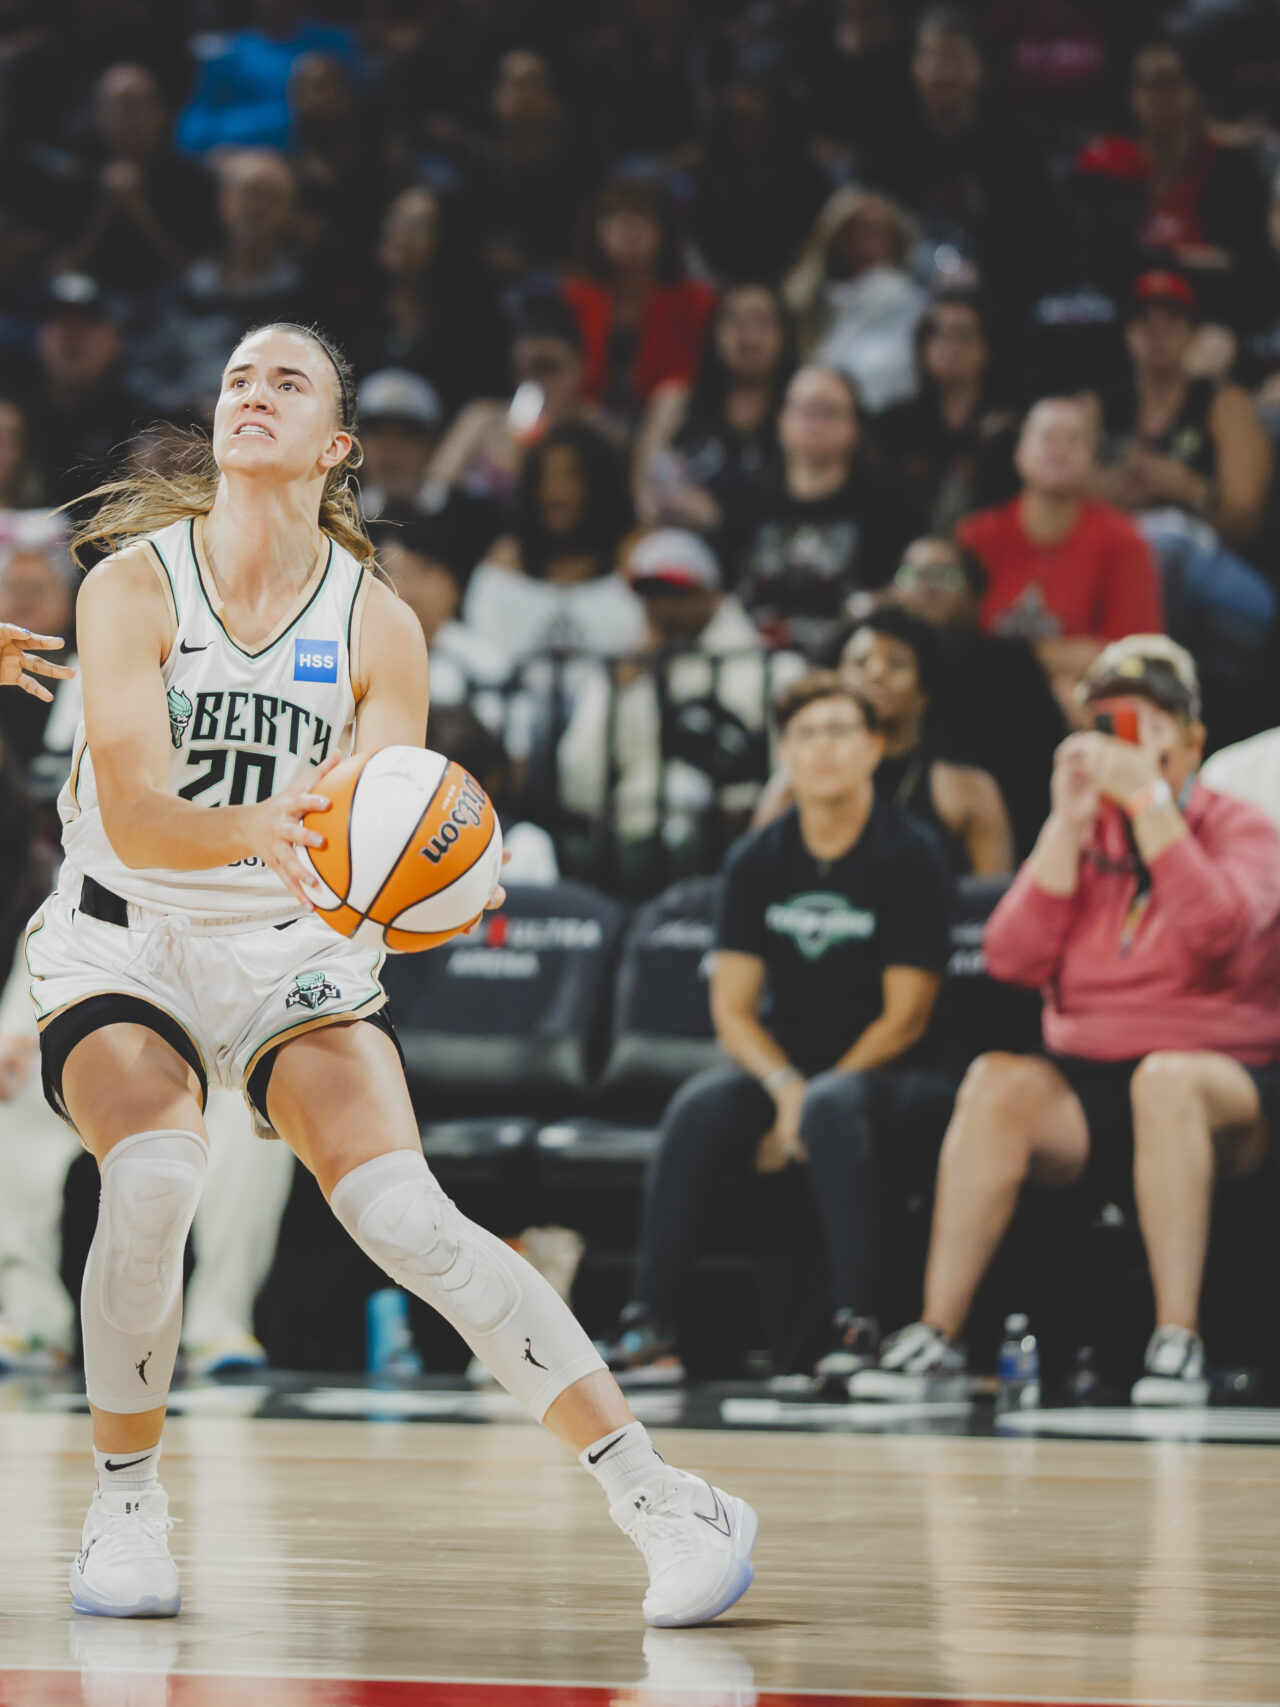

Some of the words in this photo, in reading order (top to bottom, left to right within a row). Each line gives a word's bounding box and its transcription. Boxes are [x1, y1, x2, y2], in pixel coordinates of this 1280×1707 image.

[299, 653, 334, 669] HSS
[166, 686, 332, 766] IBERTY
[178, 750, 276, 808] 20
